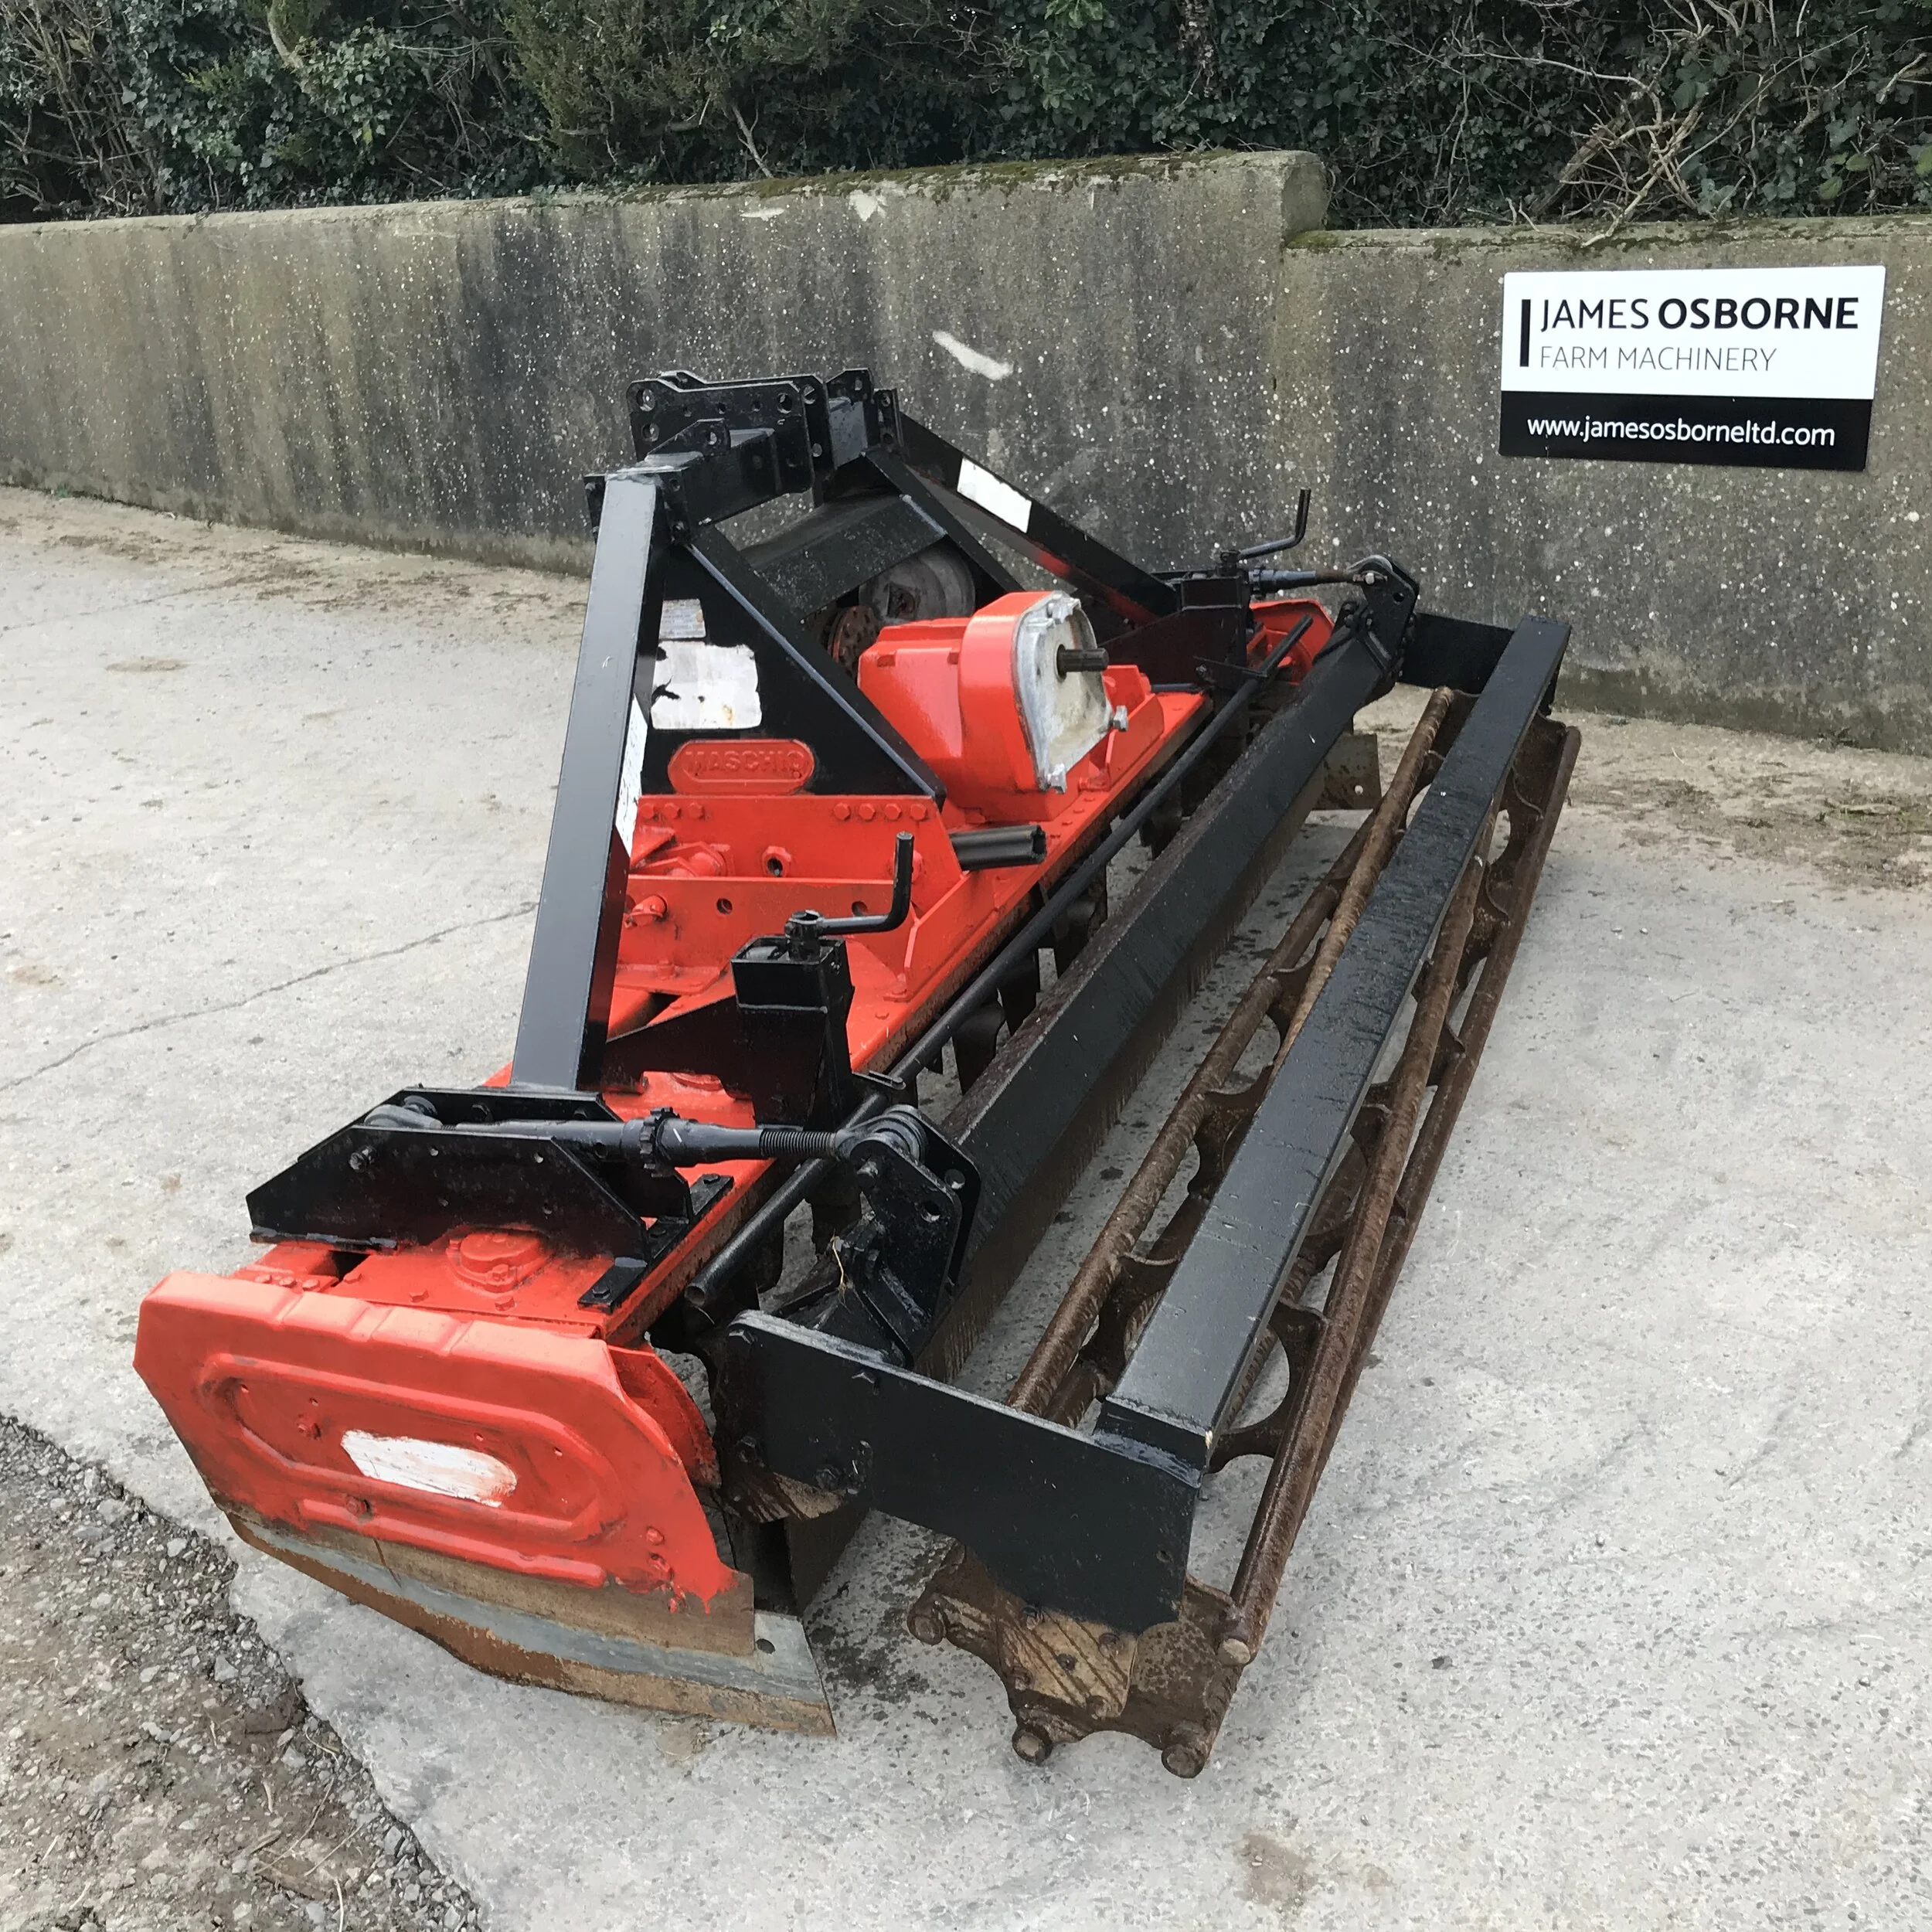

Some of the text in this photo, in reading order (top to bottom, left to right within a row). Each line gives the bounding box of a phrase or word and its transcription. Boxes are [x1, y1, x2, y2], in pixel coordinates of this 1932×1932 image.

[1540, 297, 1859, 333] JAMES OSBORNE
[1540, 345, 1777, 372] FARM MACHINERY
[1527, 415, 1835, 446] www.jamesosborneltd.com
